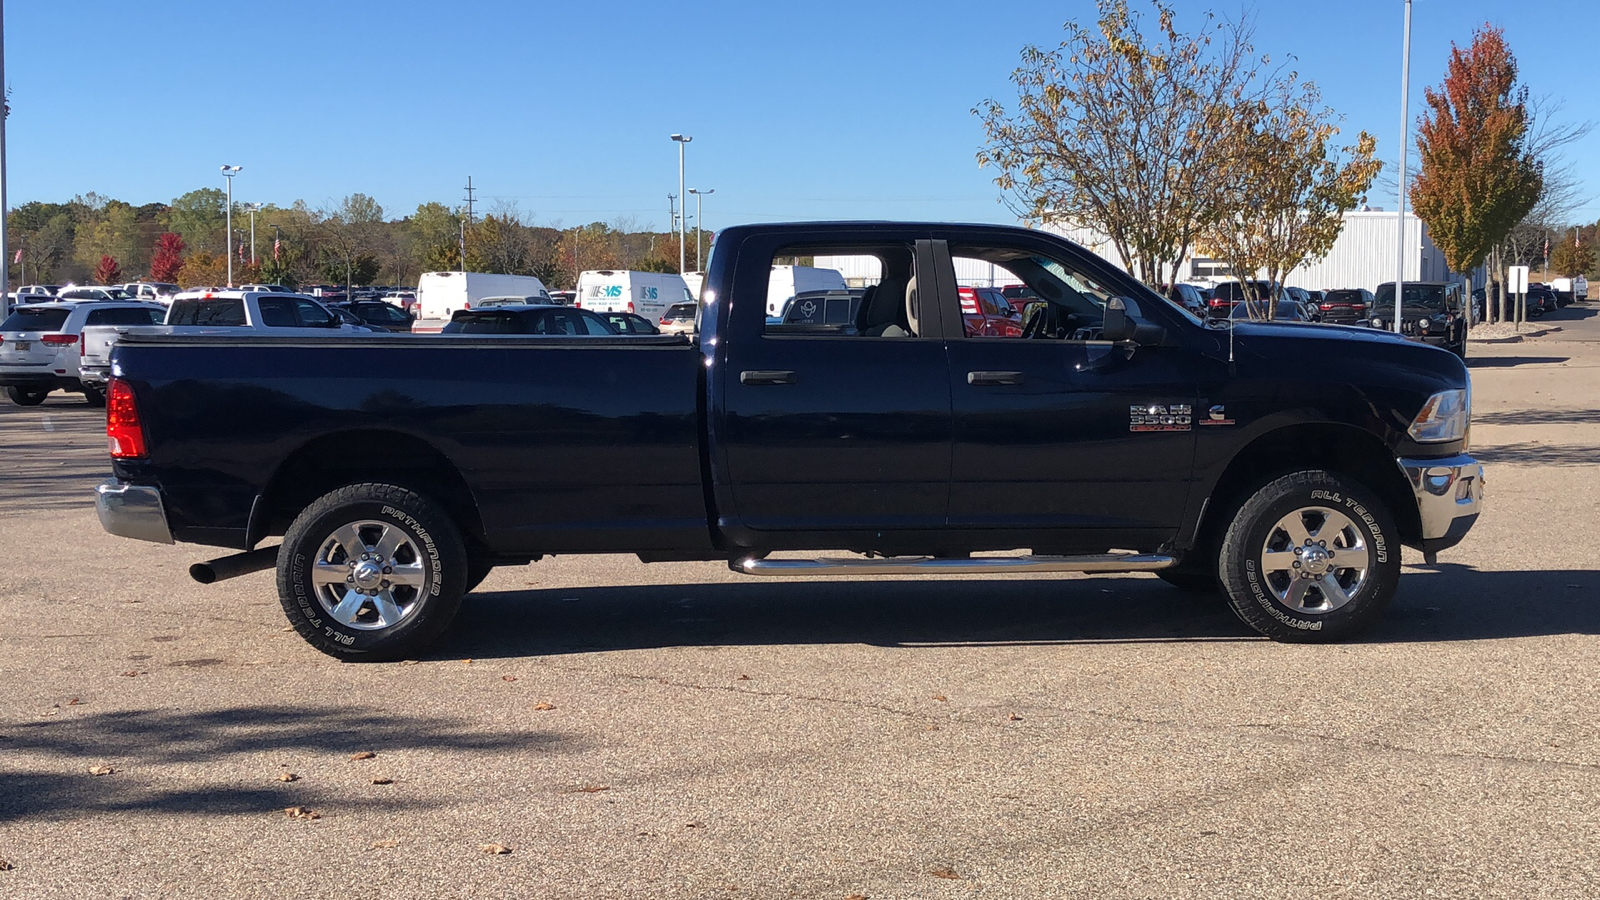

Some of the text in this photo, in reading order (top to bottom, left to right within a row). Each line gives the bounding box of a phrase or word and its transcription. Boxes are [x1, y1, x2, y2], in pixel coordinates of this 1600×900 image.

[1130, 404, 1192, 415] RAM
[1130, 415, 1192, 425] 3500
[381, 505, 442, 597] PATHFINDER
[1310, 489, 1388, 563] ALL TERRAIN
[293, 553, 356, 646] ALL TERRAIN
[1246, 559, 1323, 631] PATHFINDER
